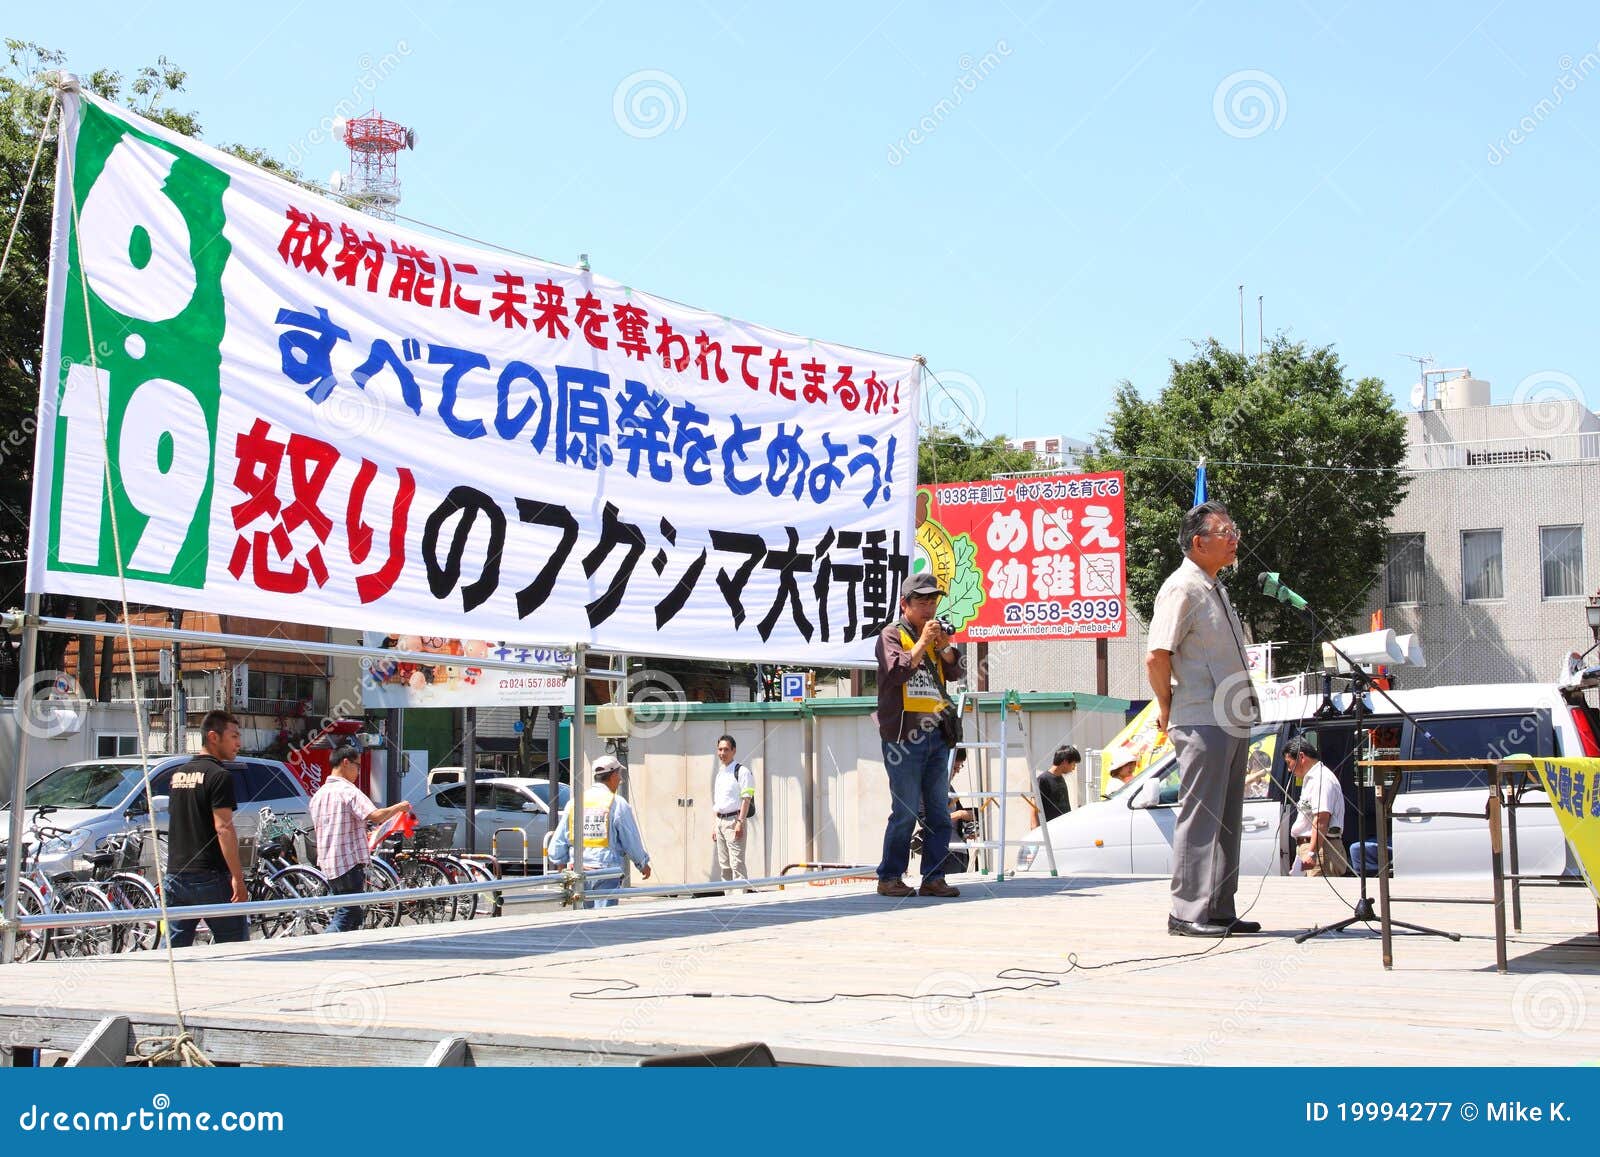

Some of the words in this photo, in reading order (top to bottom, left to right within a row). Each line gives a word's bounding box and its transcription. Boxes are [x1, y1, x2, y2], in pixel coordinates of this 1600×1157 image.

[59, 363, 211, 574] 19
[937, 479, 1119, 504] 1938年創立・伸びる力を育てる
[228, 417, 909, 644] 怒りのフクシマ大行動
[986, 505, 1120, 553] めばえ
[987, 553, 1121, 600] 幼稚園
[1025, 601, 1119, 620] 558-3939
[786, 677, 801, 696] P
